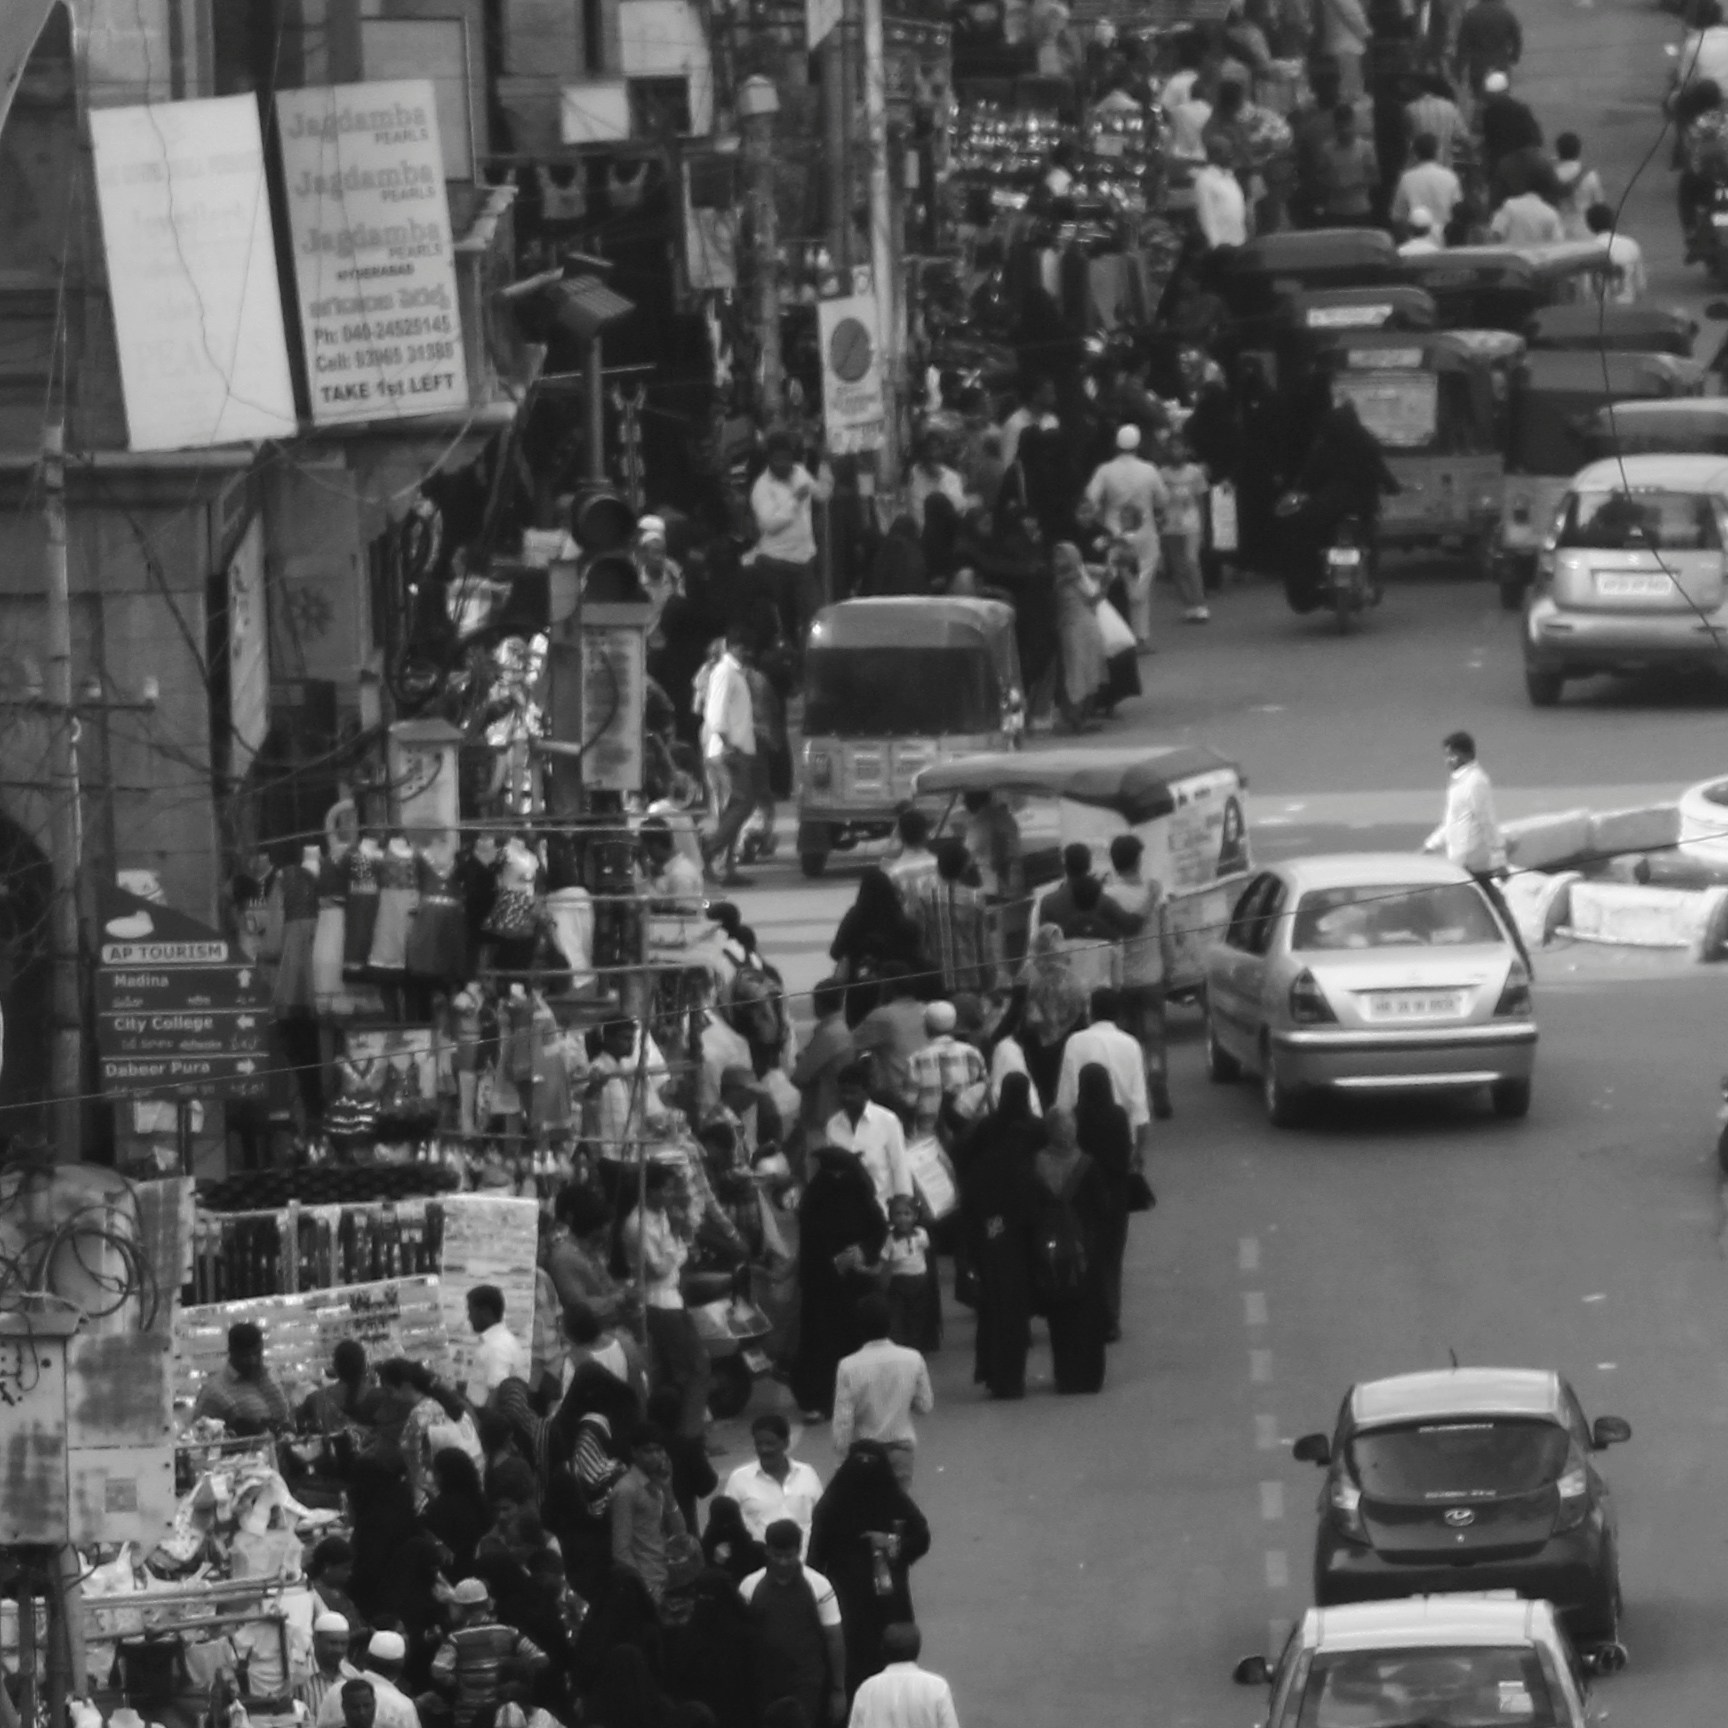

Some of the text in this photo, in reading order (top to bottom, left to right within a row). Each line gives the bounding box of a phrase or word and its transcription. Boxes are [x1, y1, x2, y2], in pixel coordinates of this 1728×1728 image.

[320, 383, 369, 403] TAKE
[409, 372, 455, 394] LEFT
[111, 943, 223, 960] AP TOURISM
[114, 973, 170, 988] Madina
[114, 1016, 214, 1033] City College
[106, 1060, 211, 1077] Dabeer Pura
